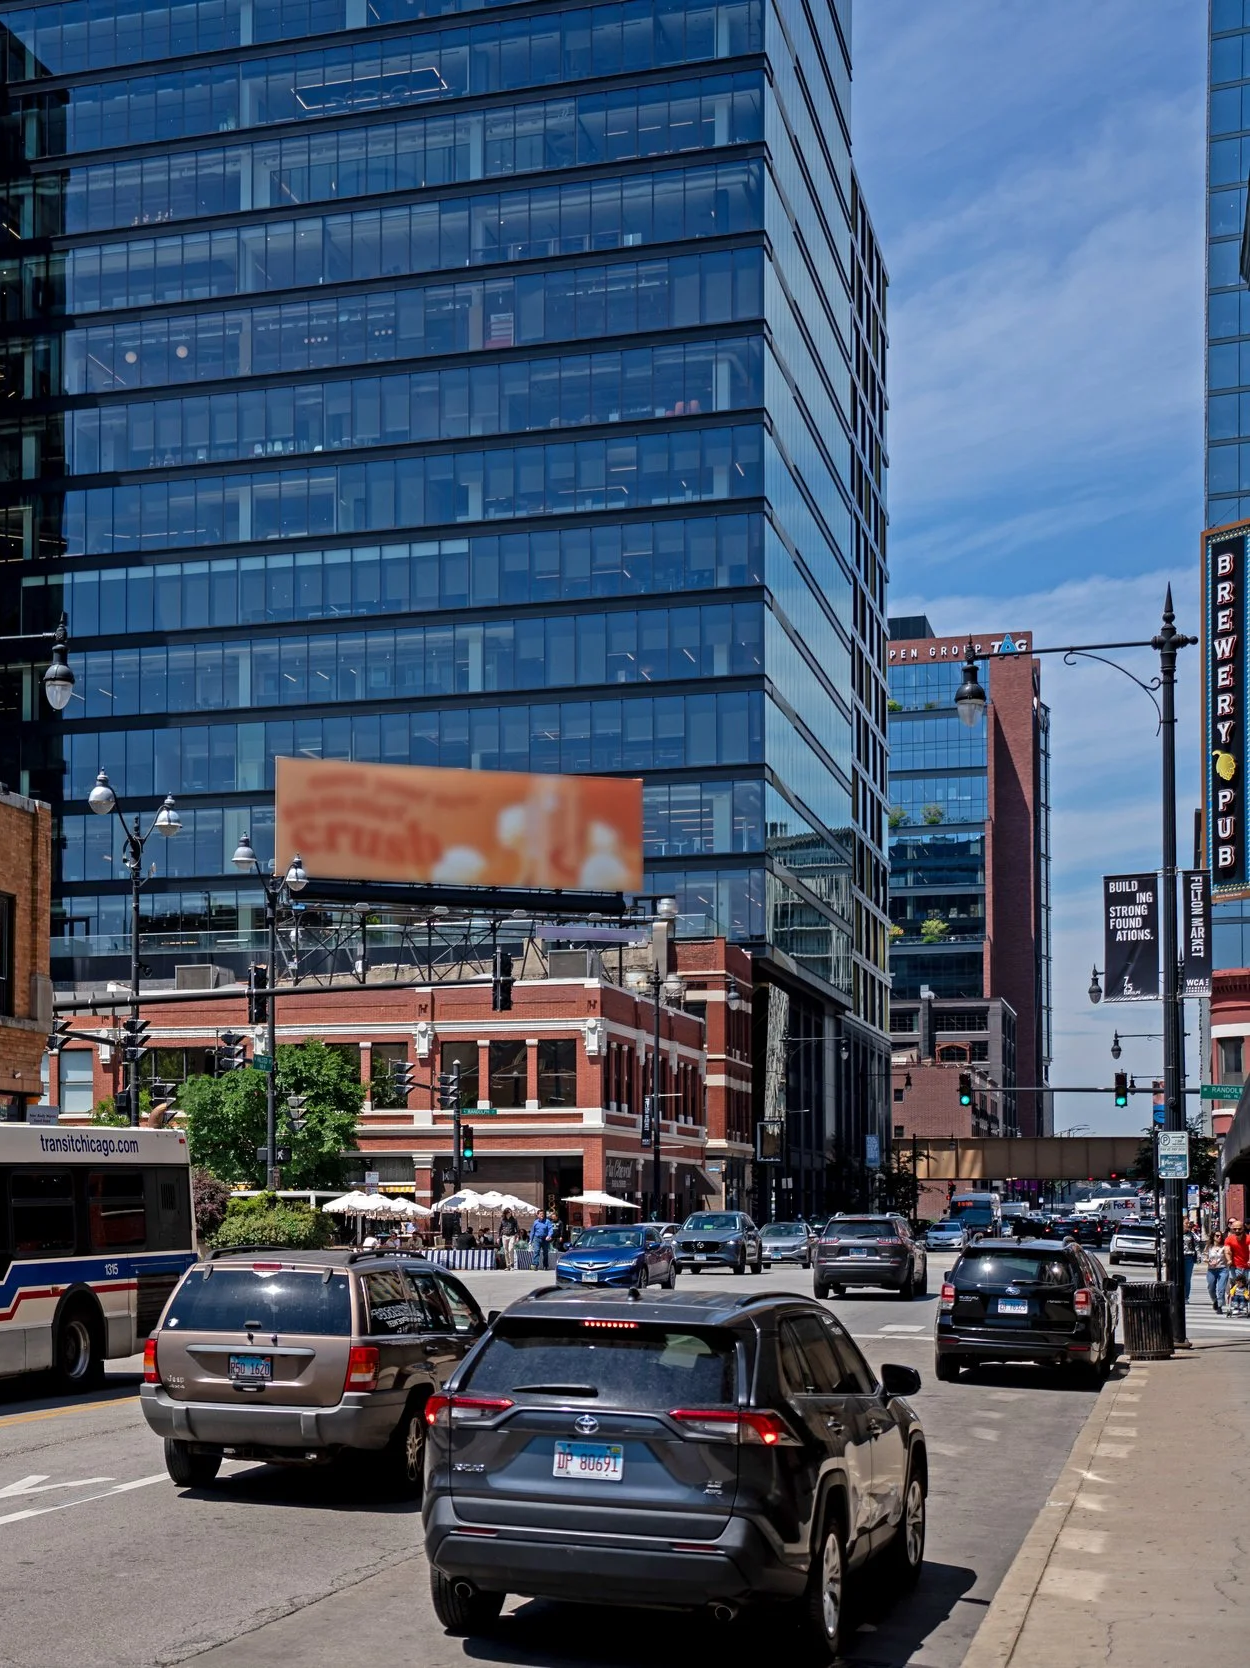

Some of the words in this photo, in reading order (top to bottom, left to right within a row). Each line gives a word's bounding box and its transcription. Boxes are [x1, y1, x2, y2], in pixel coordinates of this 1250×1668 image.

[890, 648, 918, 660] PEN
[1214, 553, 1237, 746] BREWERY
[1217, 788, 1236, 868] PUB
[1109, 880, 1138, 893] BUILD
[1136, 892, 1153, 903] ING
[1190, 876, 1204, 915] FULTON
[1109, 904, 1148, 917] STRONG
[1110, 917, 1142, 930] FOUND
[1116, 929, 1154, 941] ATIONS.
[1190, 917, 1205, 957] MARKET
[1186, 979, 1204, 987] WCA
[40, 1134, 139, 1156] transitchicago.com
[1113, 1200, 1136, 1209] FedEx
[104, 1264, 118, 1275] 1315
[250, 1362, 270, 1376] 1620
[167, 1375, 185, 1383] Jeep
[557, 1451, 573, 1469] DP
[579, 1453, 618, 1472] 80691
